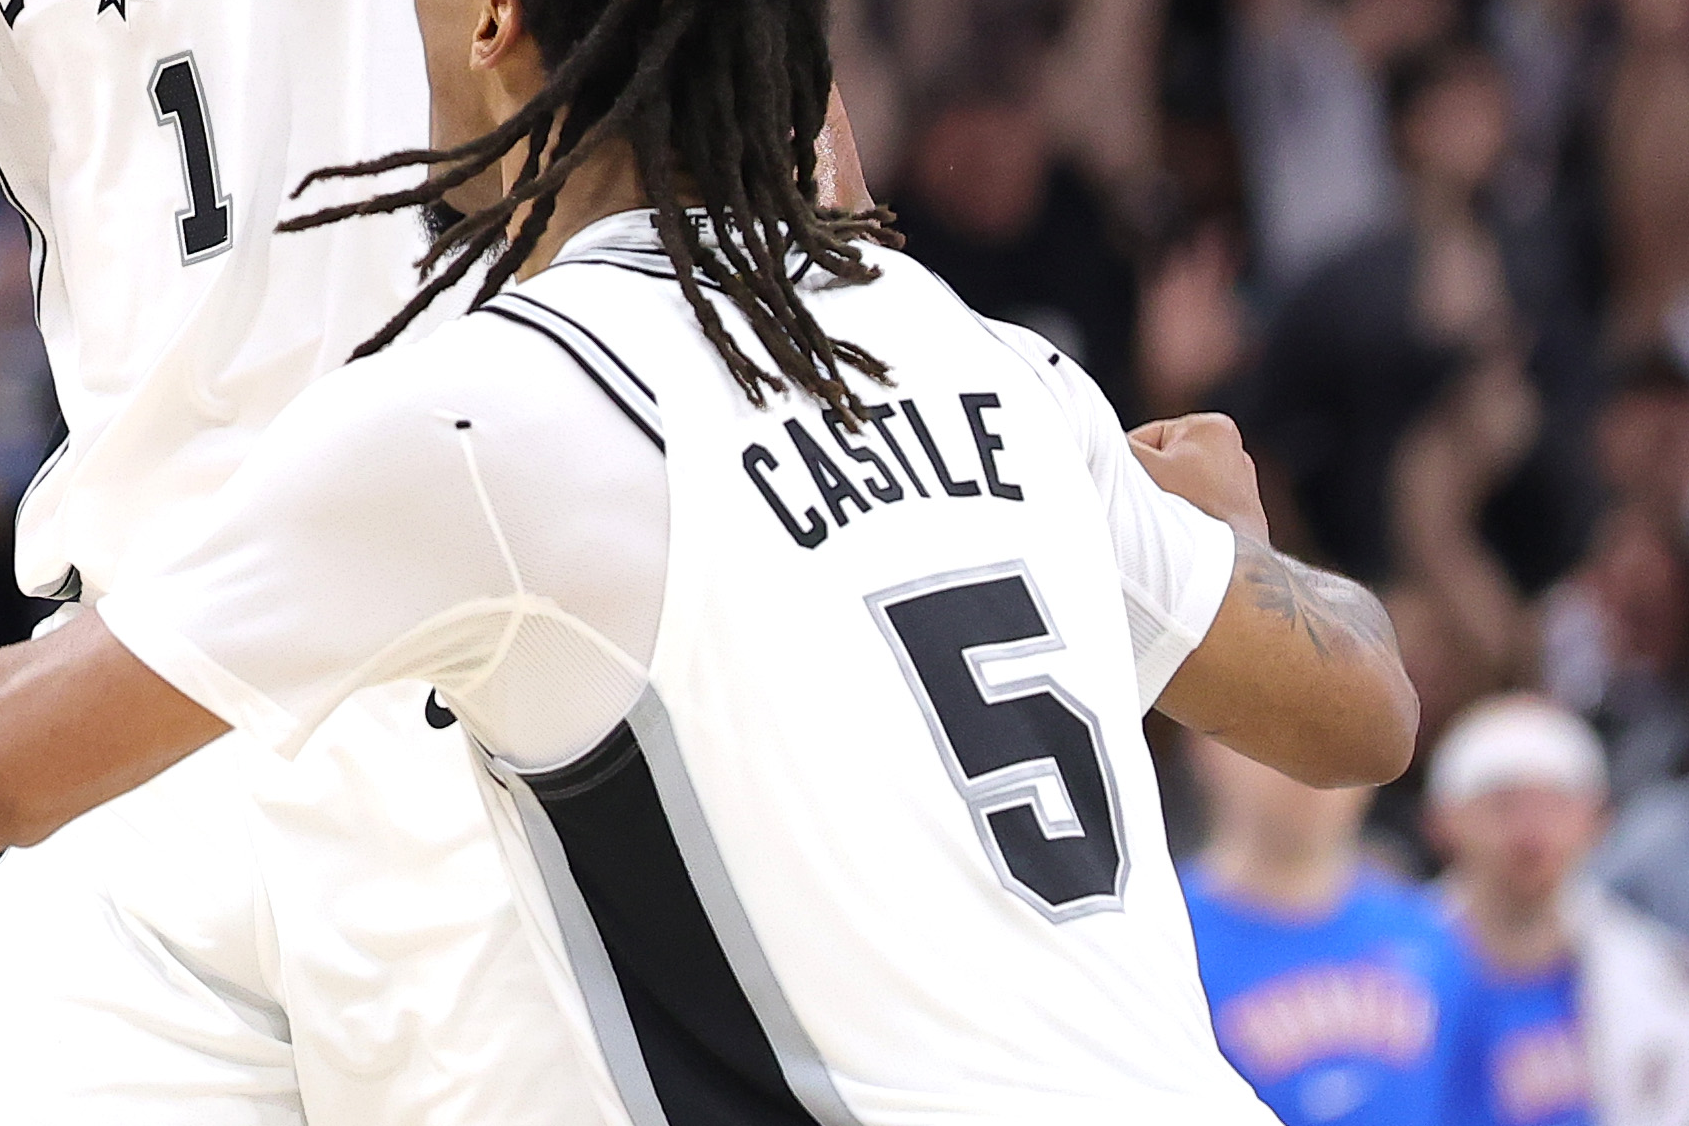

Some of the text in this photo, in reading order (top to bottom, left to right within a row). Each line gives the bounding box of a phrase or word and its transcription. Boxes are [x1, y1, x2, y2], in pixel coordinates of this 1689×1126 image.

[146, 50, 233, 267] 1
[742, 392, 1025, 550] CASTLE
[862, 558, 1132, 926] 5
